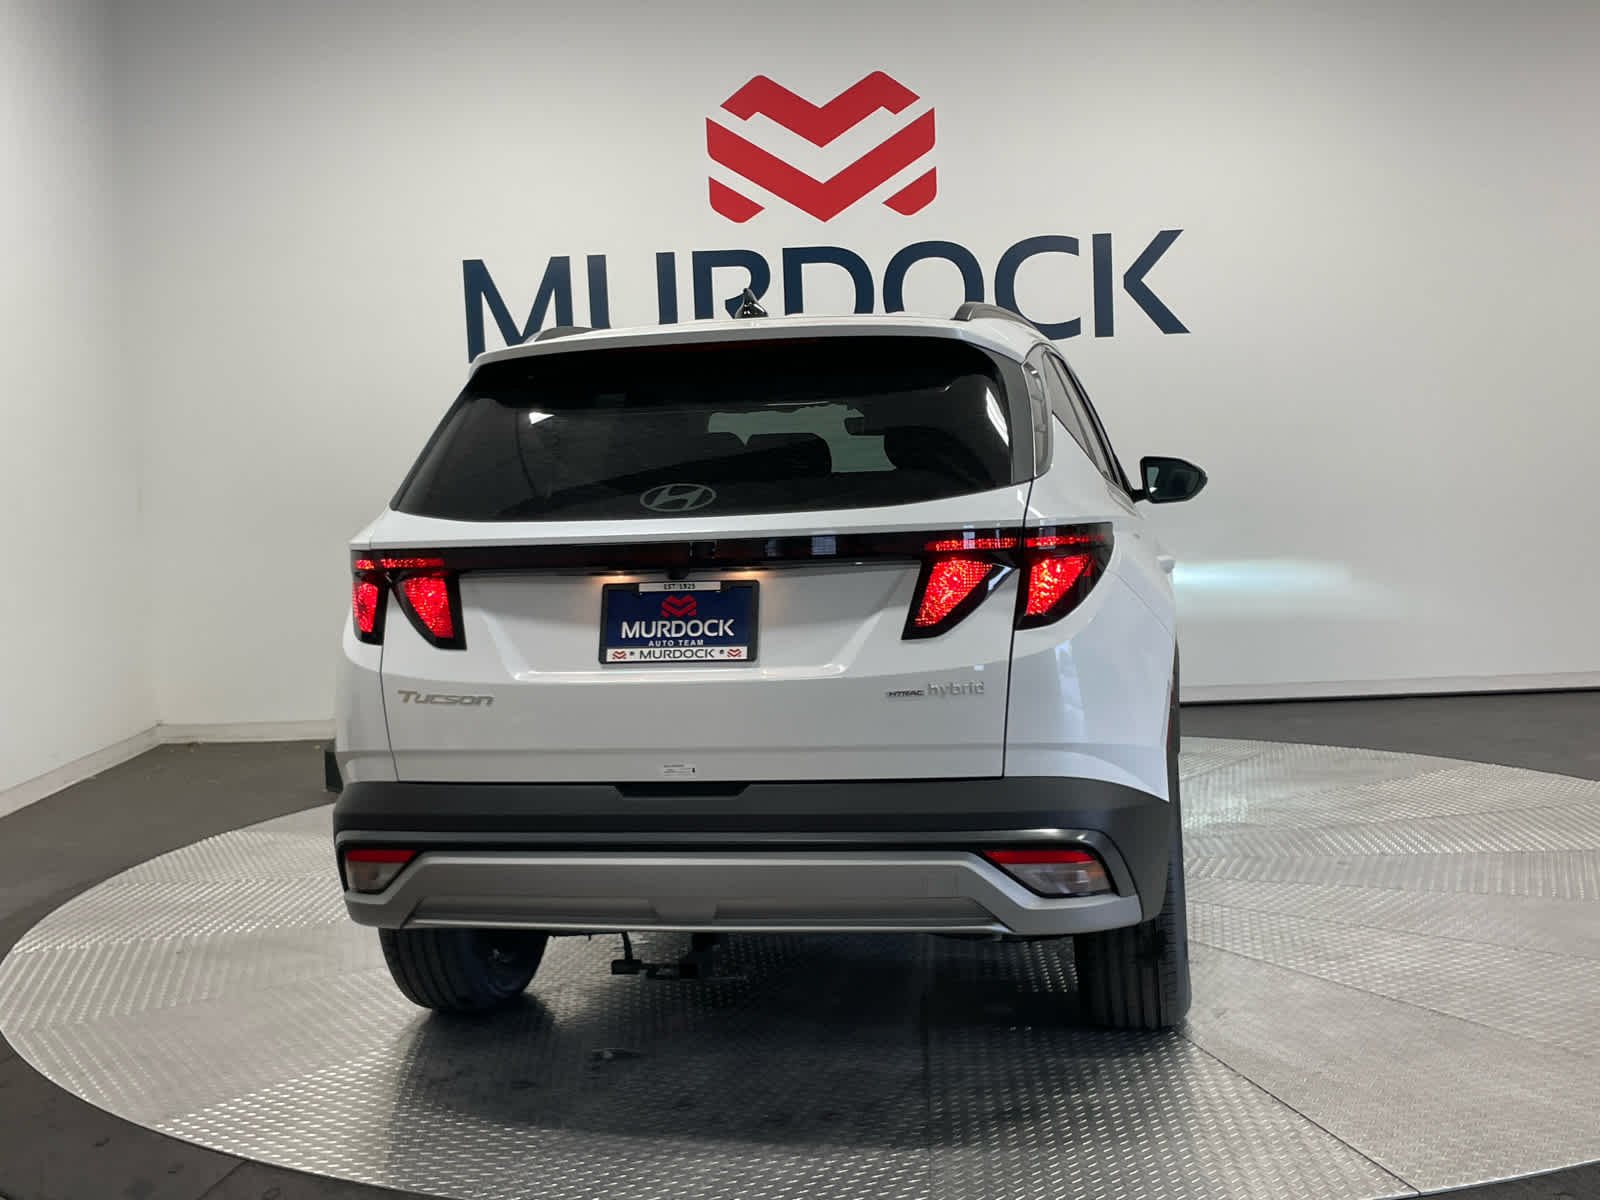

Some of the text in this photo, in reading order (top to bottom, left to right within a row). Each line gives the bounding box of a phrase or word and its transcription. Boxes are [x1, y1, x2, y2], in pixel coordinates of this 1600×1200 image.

[462, 228, 1190, 363] MURDOCK
[621, 619, 735, 638] MURDOCK
[639, 648, 715, 660] MURDOCK
[927, 680, 985, 699] hybrid
